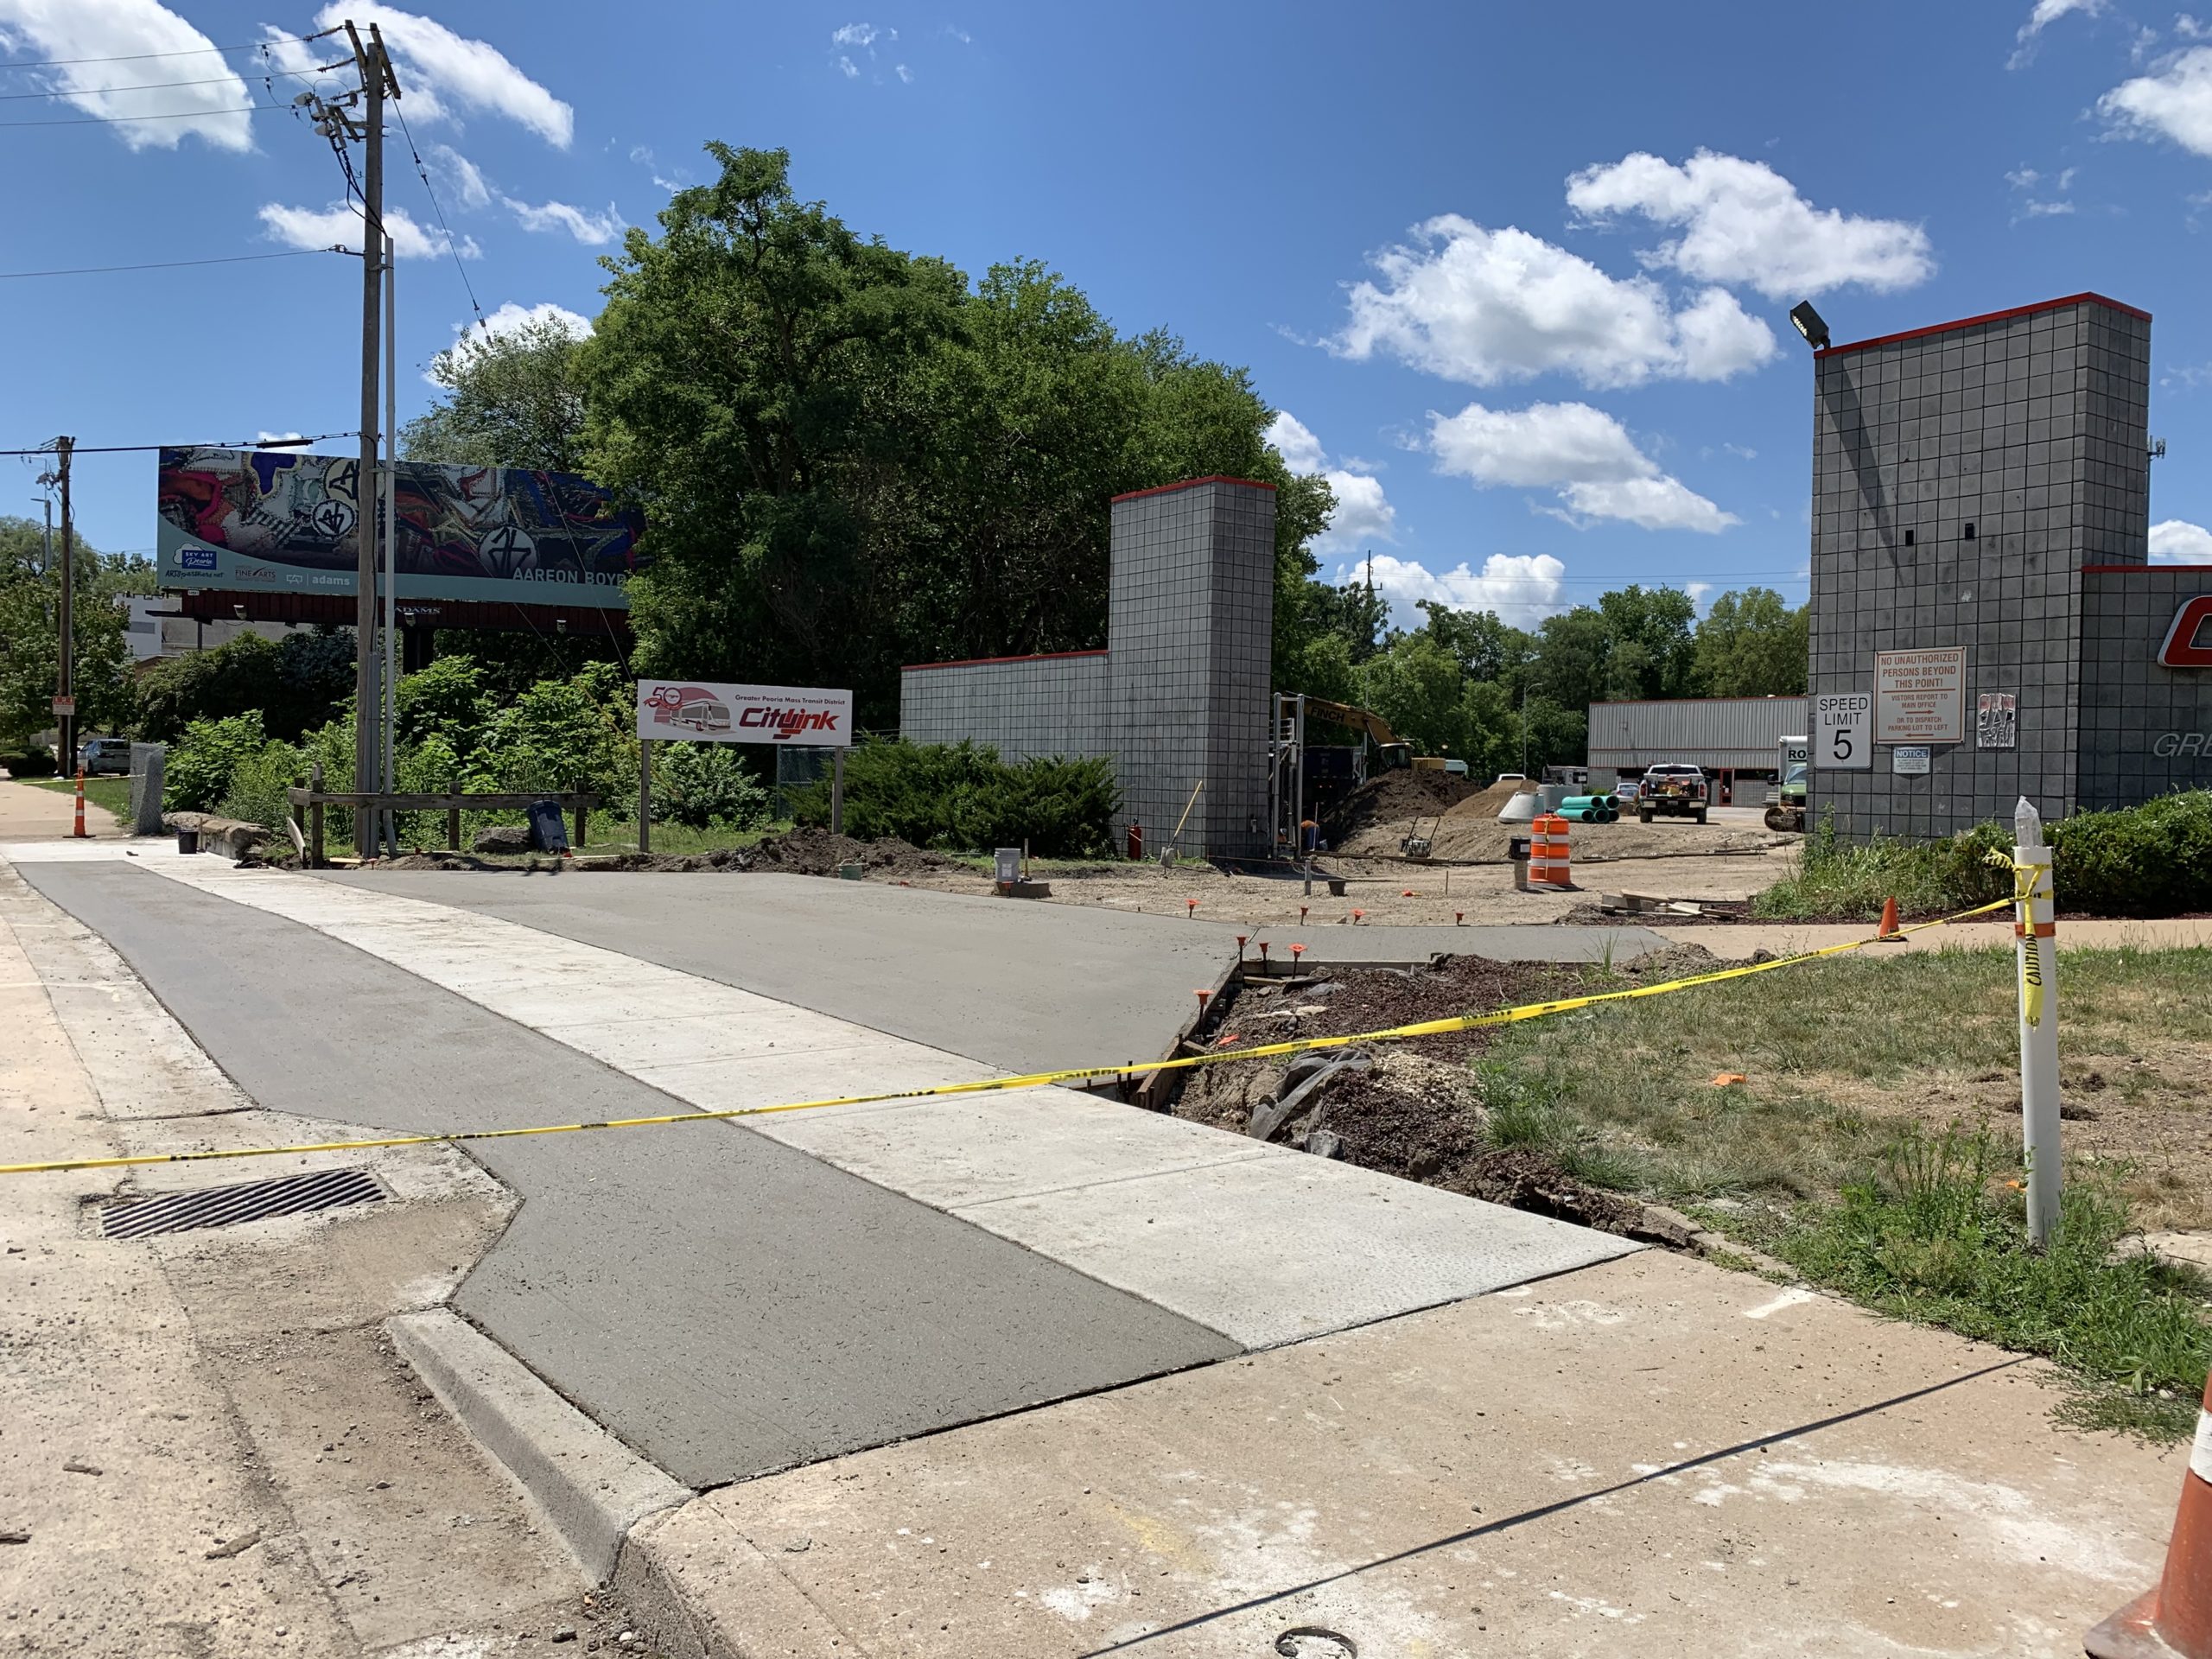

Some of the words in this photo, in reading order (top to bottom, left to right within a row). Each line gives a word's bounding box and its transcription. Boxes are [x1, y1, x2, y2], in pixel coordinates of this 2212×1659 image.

[311, 575, 350, 586] adams
[512, 567, 578, 583] AAREON
[1881, 657, 1892, 666] NO
[1894, 652, 1959, 665] UNAUTHORIZED
[1882, 667, 1920, 677] PERSONS
[1922, 665, 1956, 676] BEYOND
[1895, 679, 1913, 689] THIS
[1915, 677, 1943, 688] POINT!
[1819, 697, 1868, 711] SPEED
[1310, 707, 1345, 723] FINCH
[1824, 712, 1862, 726] LIMIT
[1833, 729, 1853, 760] 5
[2025, 934, 2043, 987] CAUTION
